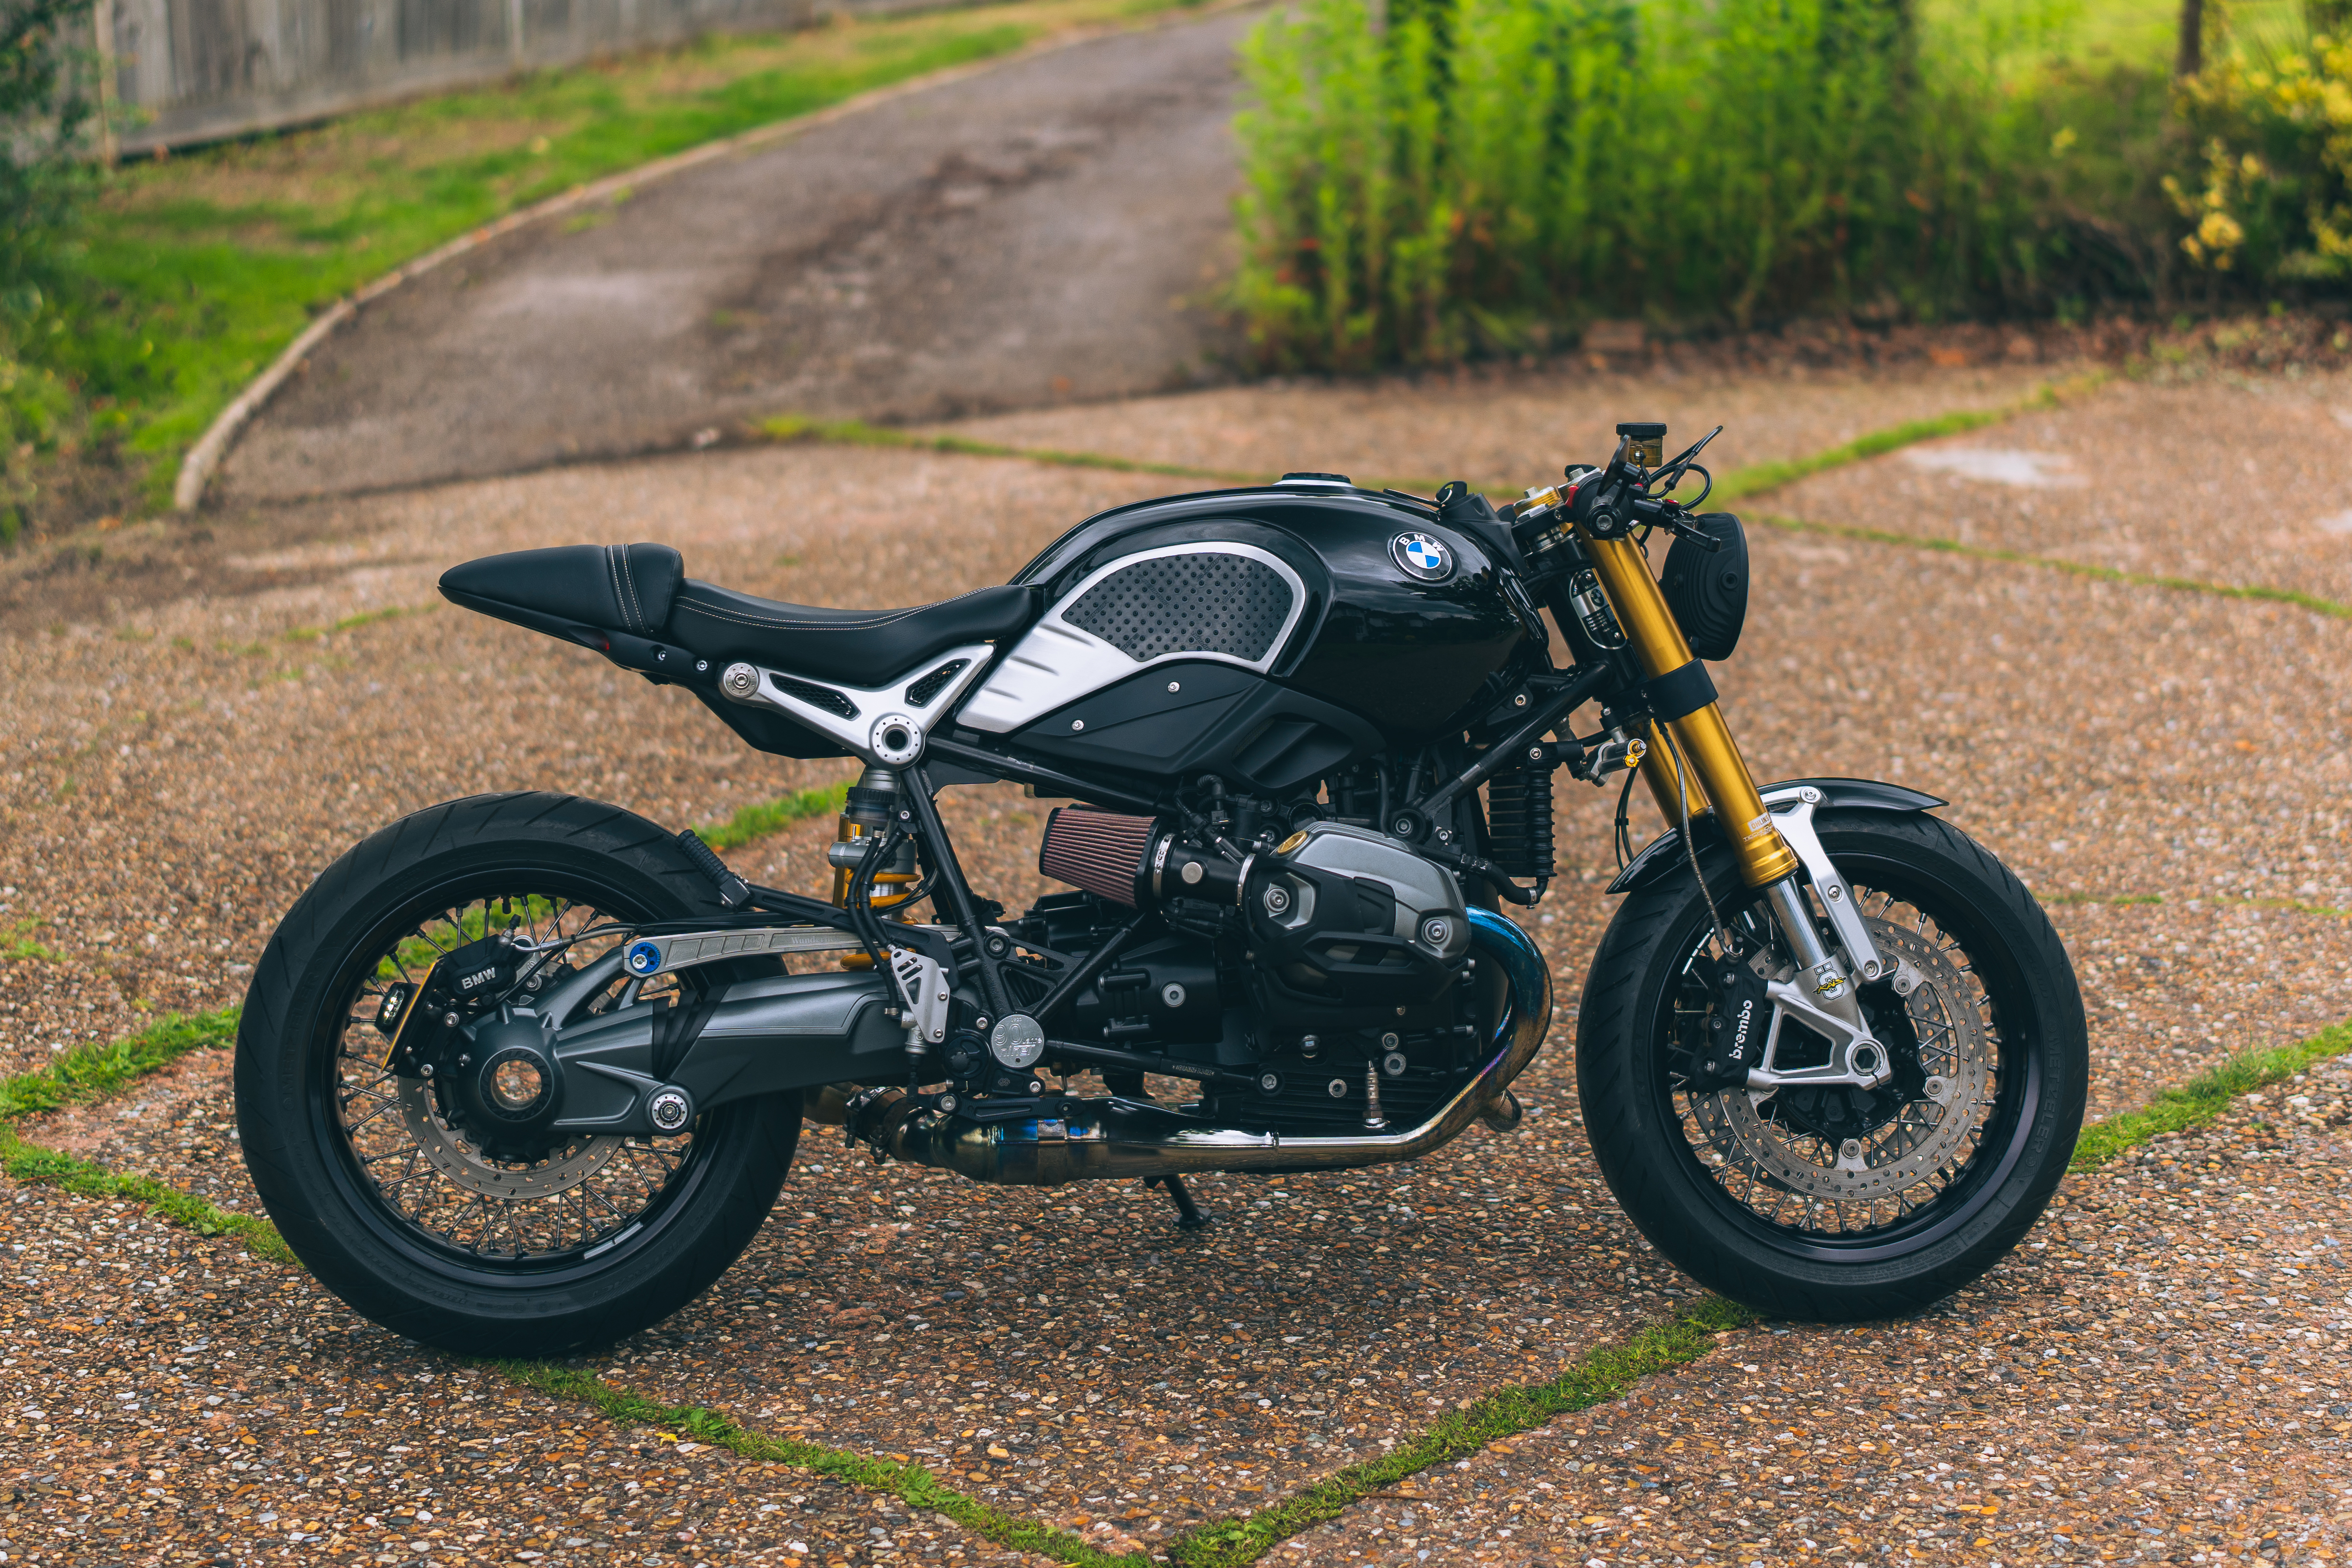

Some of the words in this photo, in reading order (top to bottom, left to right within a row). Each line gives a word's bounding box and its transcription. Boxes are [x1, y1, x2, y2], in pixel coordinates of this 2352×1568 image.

[1398, 533, 1444, 552] BMW
[1750, 815, 1769, 829] ÖHLINS
[462, 967, 496, 990] BMW
[994, 1023, 1023, 1046] 90
[1729, 999, 1753, 1060] brembo
[2030, 1033, 2060, 1154] METZELER
